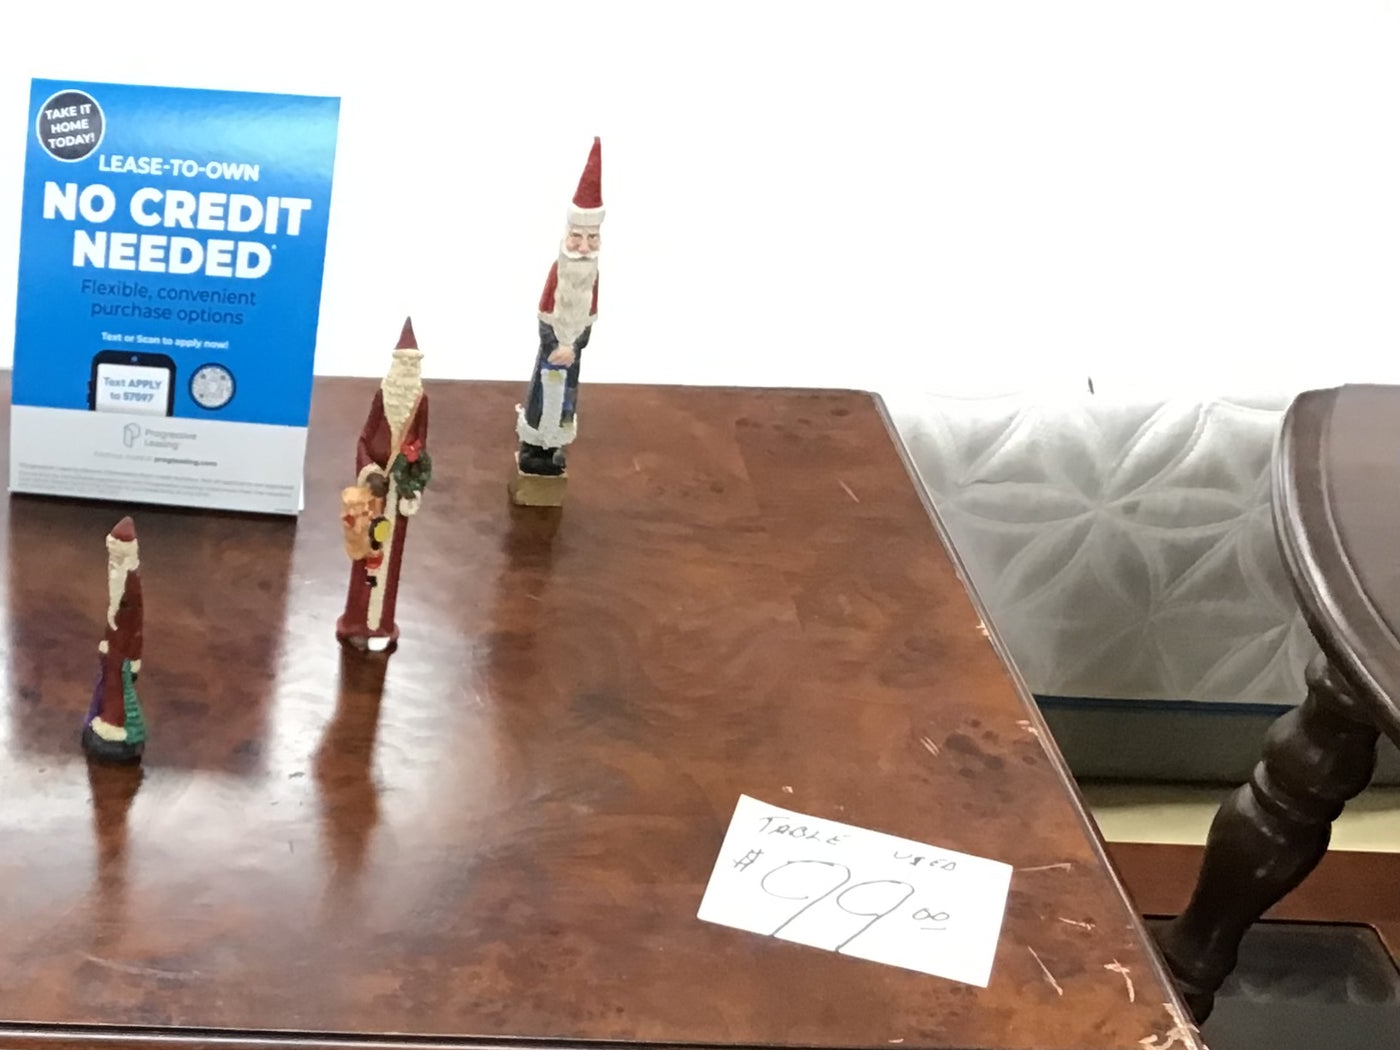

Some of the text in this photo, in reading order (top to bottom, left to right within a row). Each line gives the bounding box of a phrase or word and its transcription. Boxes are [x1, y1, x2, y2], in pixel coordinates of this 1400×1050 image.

[45, 103, 92, 120] TAKE IT
[51, 119, 90, 133] HOME
[48, 132, 95, 149] TODAY!
[99, 154, 260, 182] LEASE-TO-OWN
[43, 181, 312, 236] NO CREDIT
[81, 279, 256, 306] Flexible, convenient
[91, 302, 244, 325] purchase options
[101, 331, 122, 342] Text
[137, 335, 160, 345] Scan
[162, 337, 174, 346] to
[175, 339, 202, 349] apply
[204, 340, 229, 349] now!
[104, 377, 162, 390] Text APPLY
[110, 392, 121, 400] to
